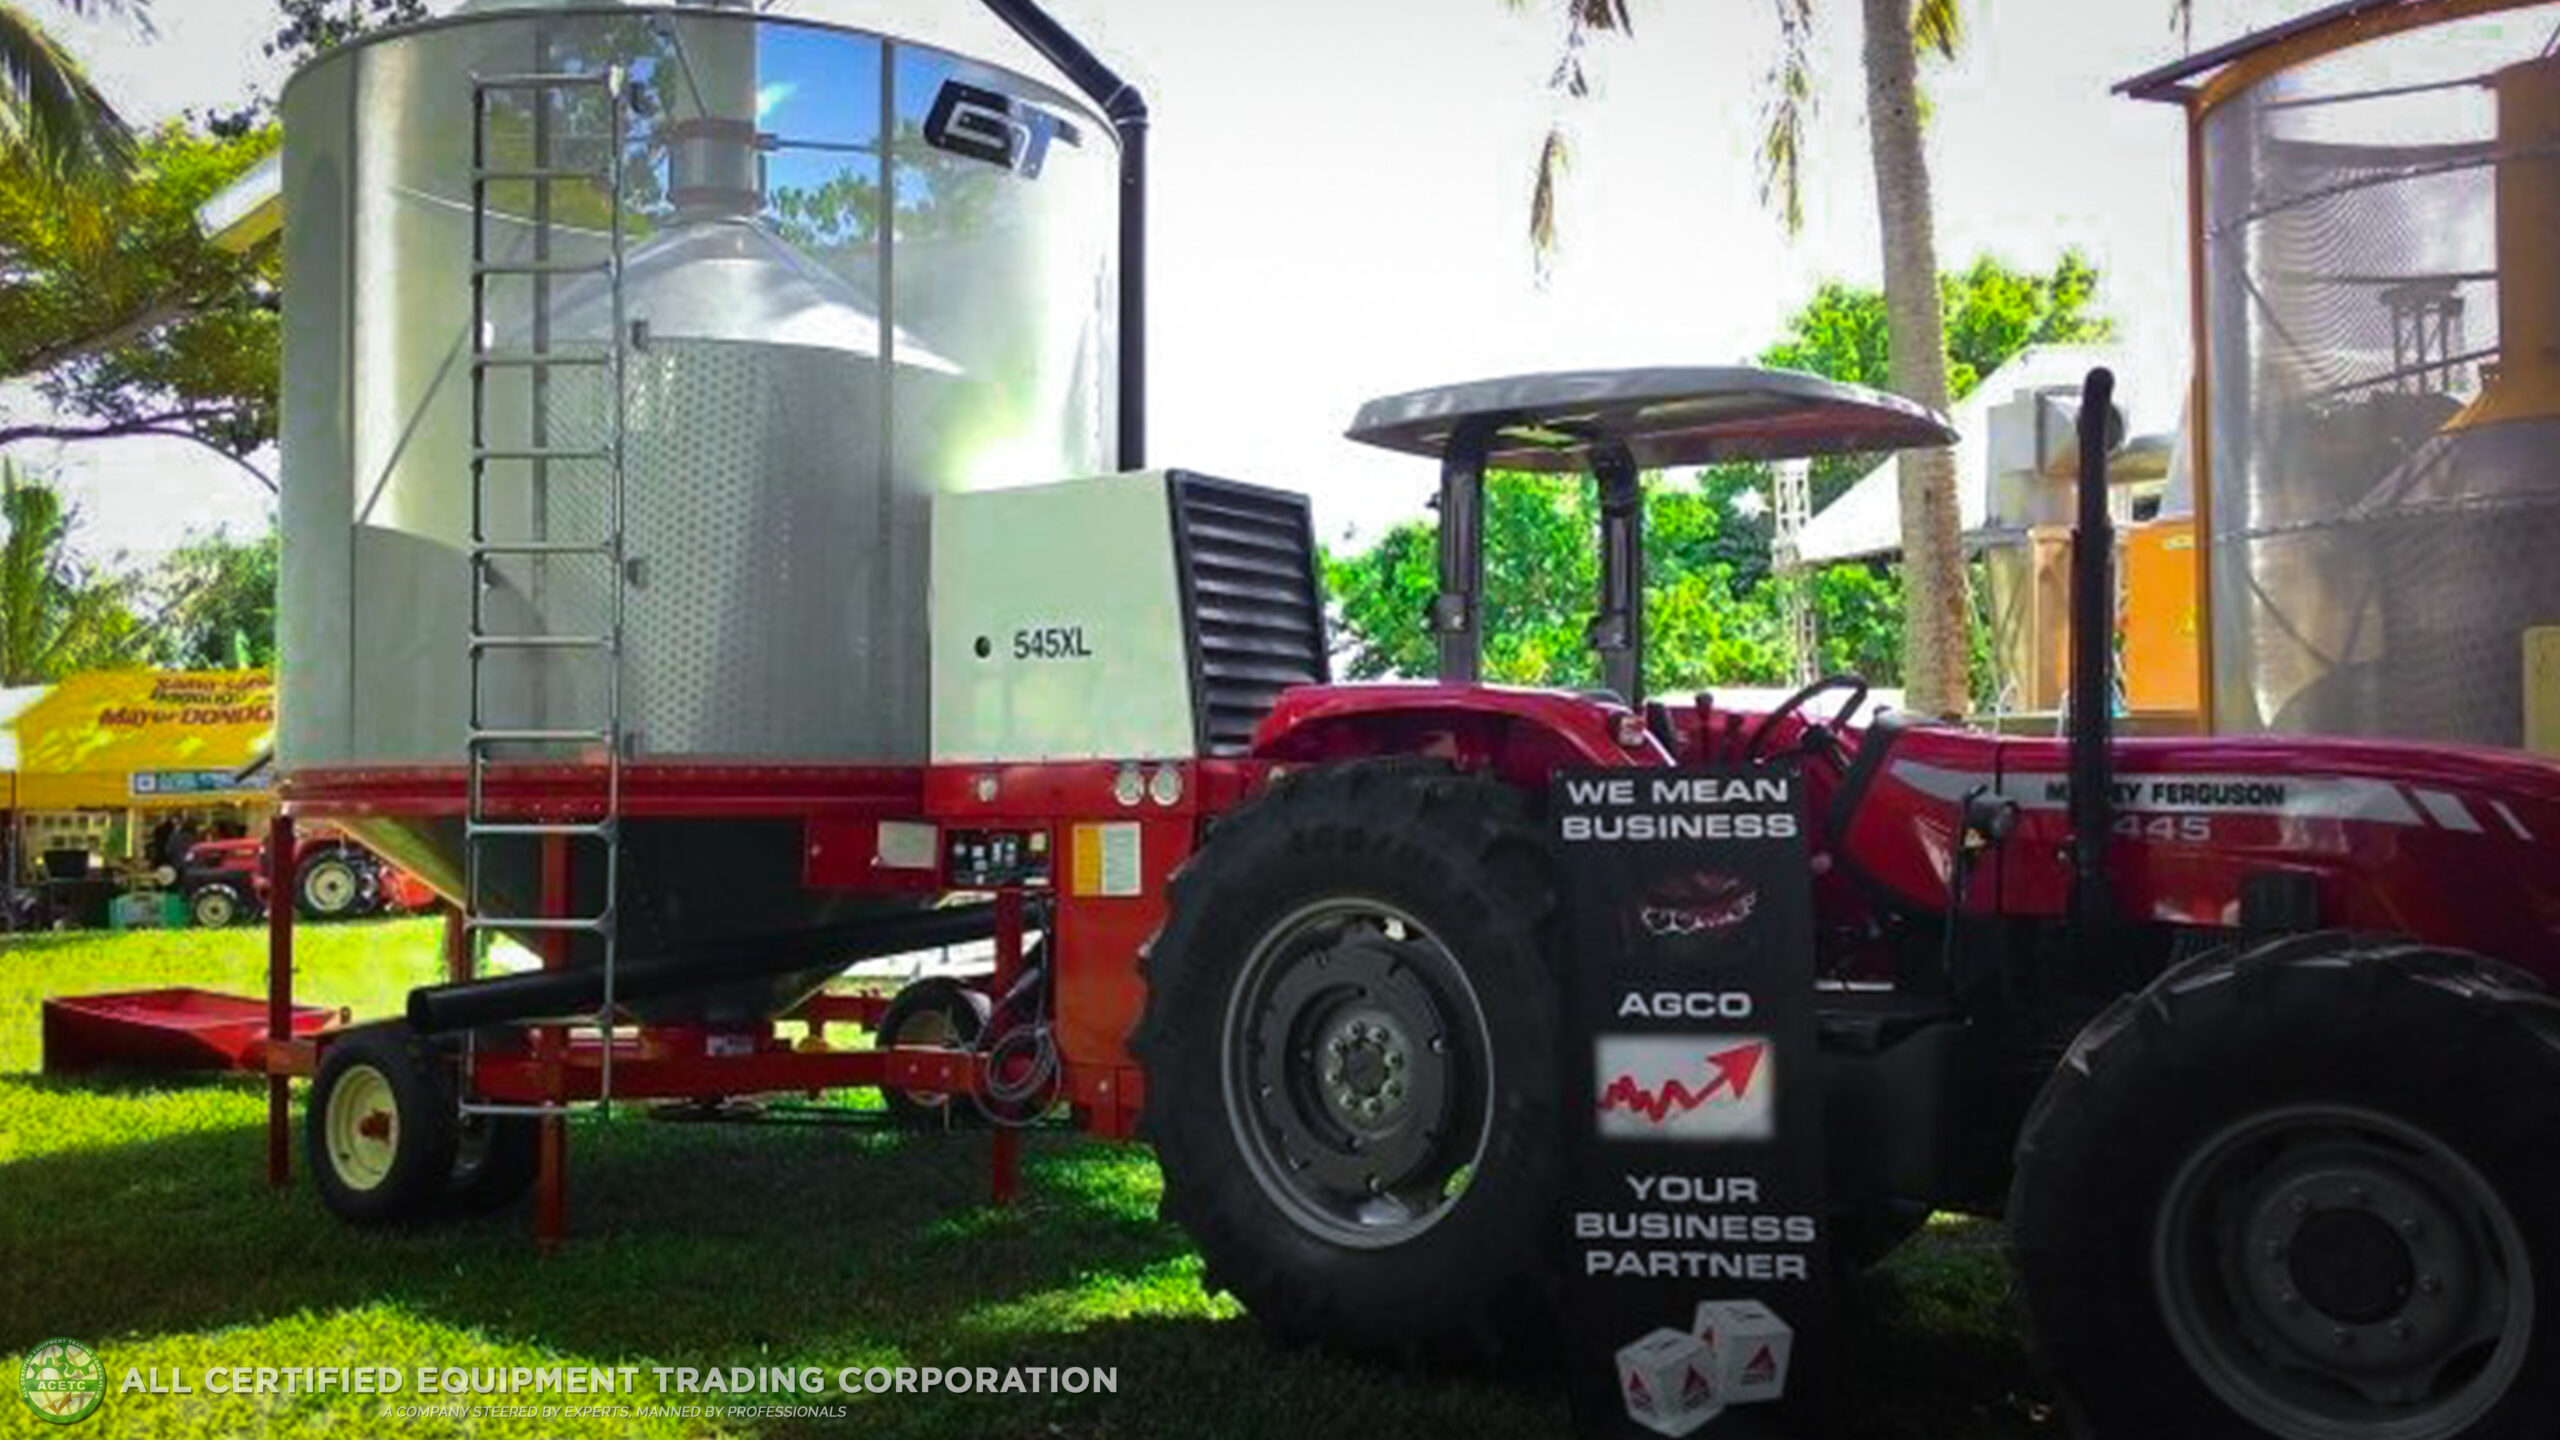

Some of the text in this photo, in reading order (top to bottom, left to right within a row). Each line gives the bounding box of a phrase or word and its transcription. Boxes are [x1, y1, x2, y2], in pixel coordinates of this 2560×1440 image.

[1013, 626, 1092, 660] 545XL
[99, 706, 181, 728] Mayor
[1567, 778, 1788, 804] WE MEAN
[2151, 782, 2286, 806] FERGUSON
[1562, 813, 1798, 841] BUSINESS
[1618, 992, 1752, 1018] AGCO
[1626, 1175, 1759, 1203] YOUR
[1574, 1212, 1816, 1242] BUSINESS
[1585, 1250, 1807, 1281] PARTNER
